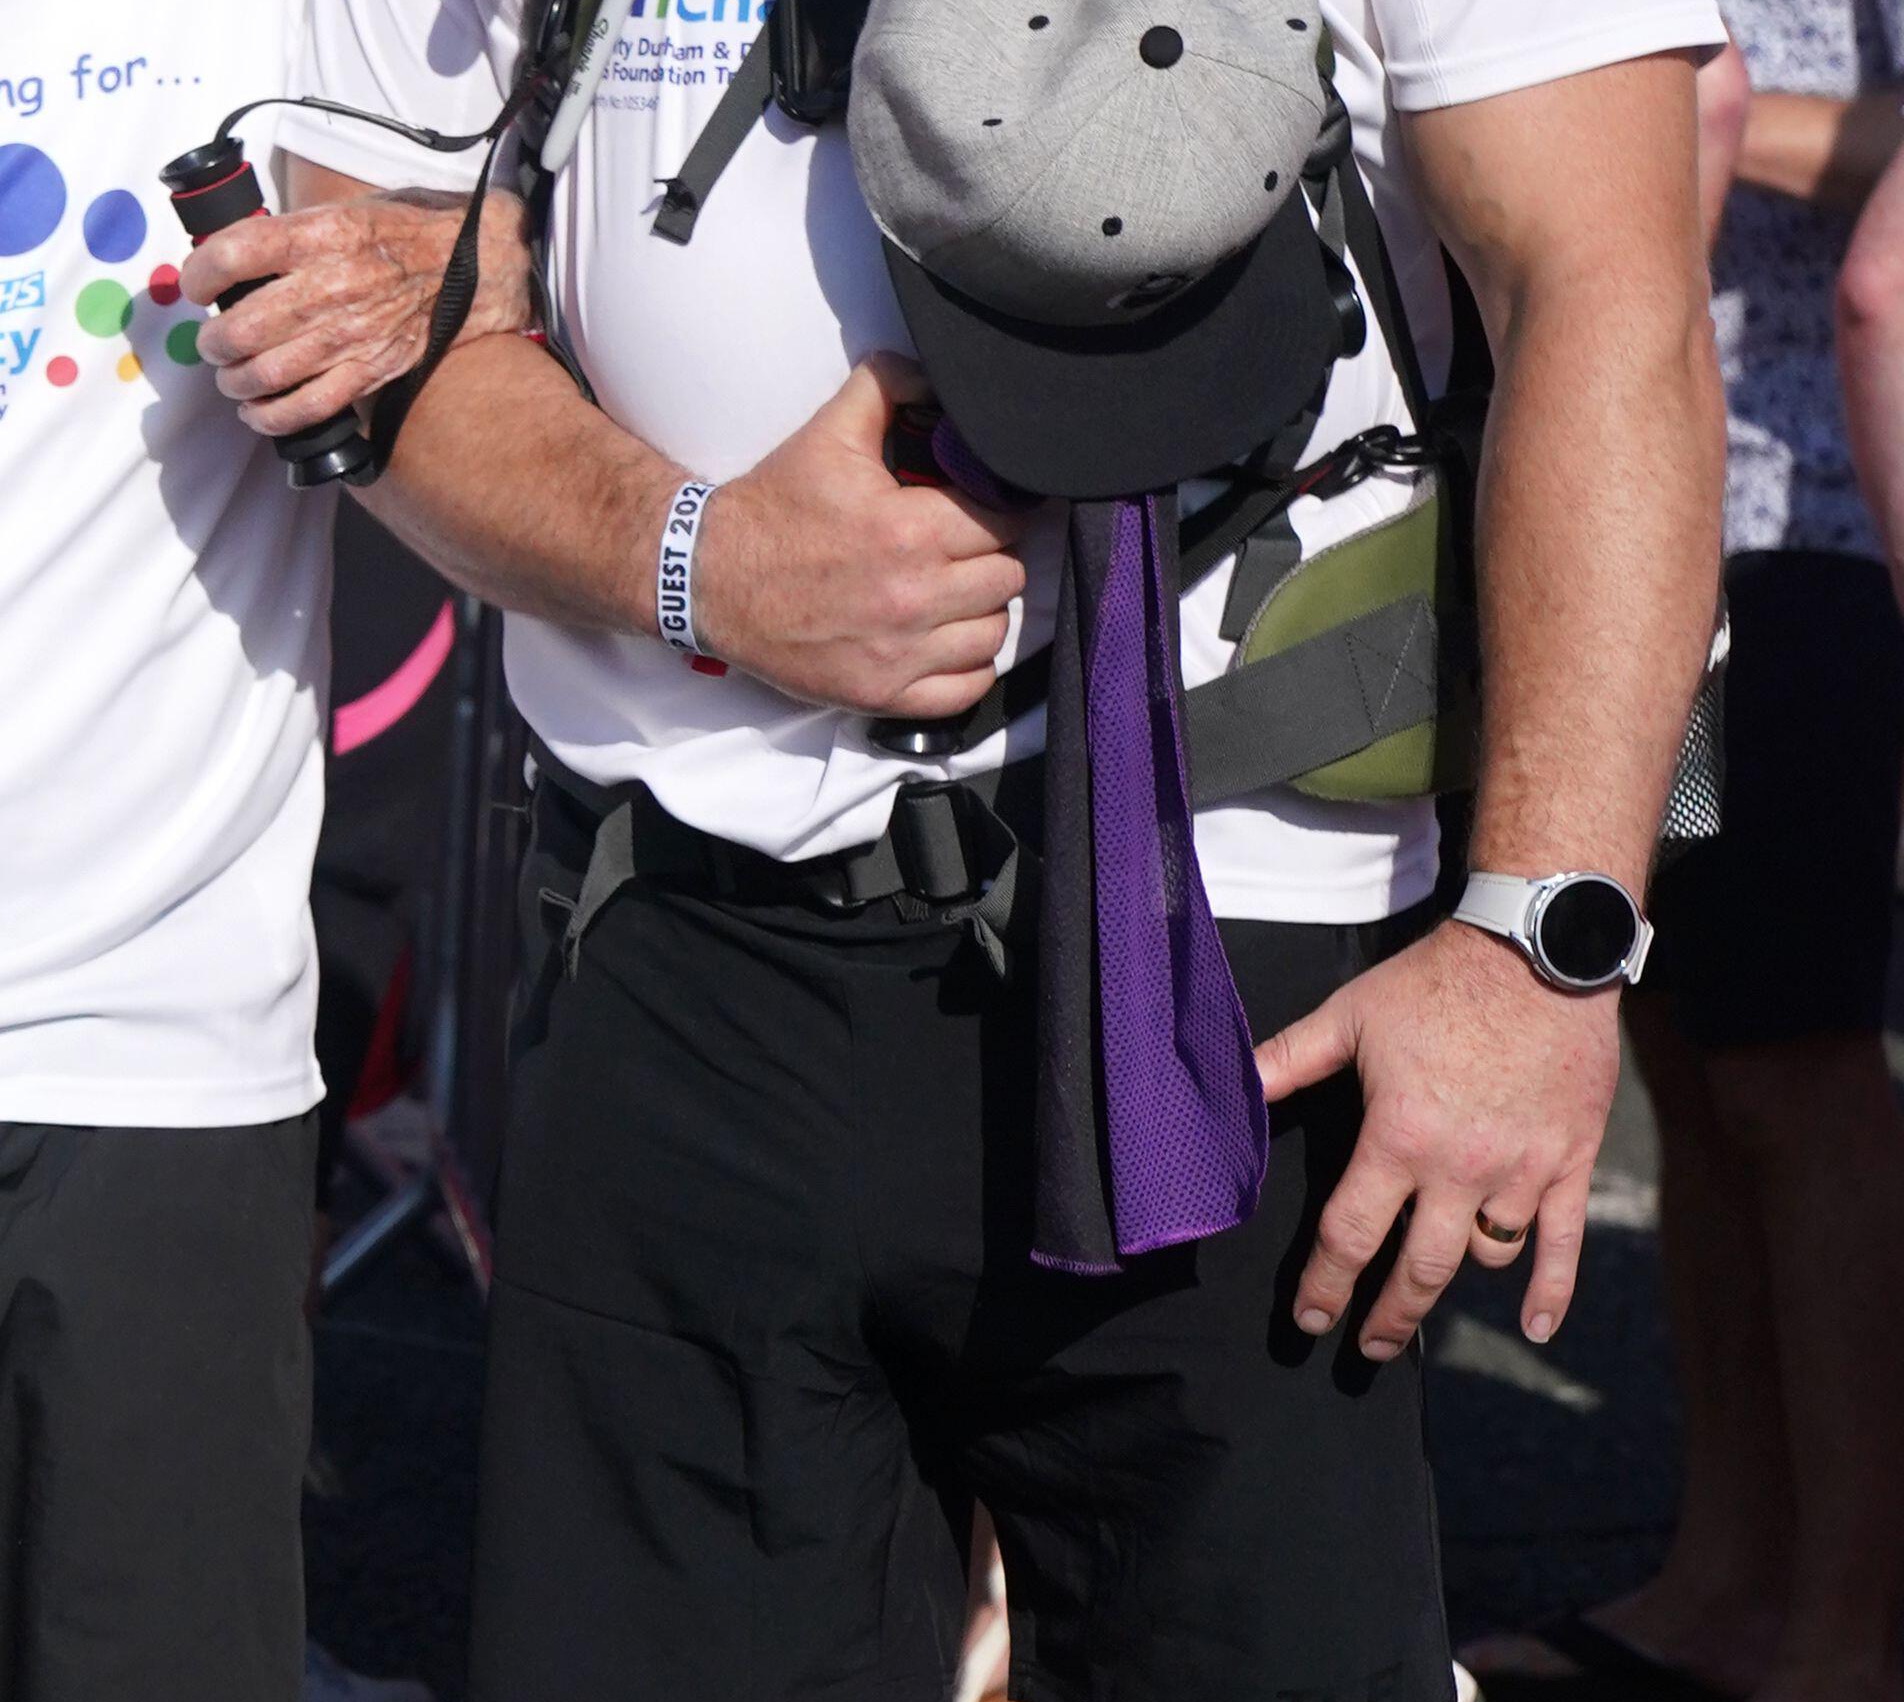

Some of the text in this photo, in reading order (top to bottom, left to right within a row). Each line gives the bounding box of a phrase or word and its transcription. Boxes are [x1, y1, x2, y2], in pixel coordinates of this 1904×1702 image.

[638, 36, 704, 61] Durham
[713, 41, 731, 60] &
[668, 482, 712, 537] 202
[662, 546, 688, 633] GUEST
